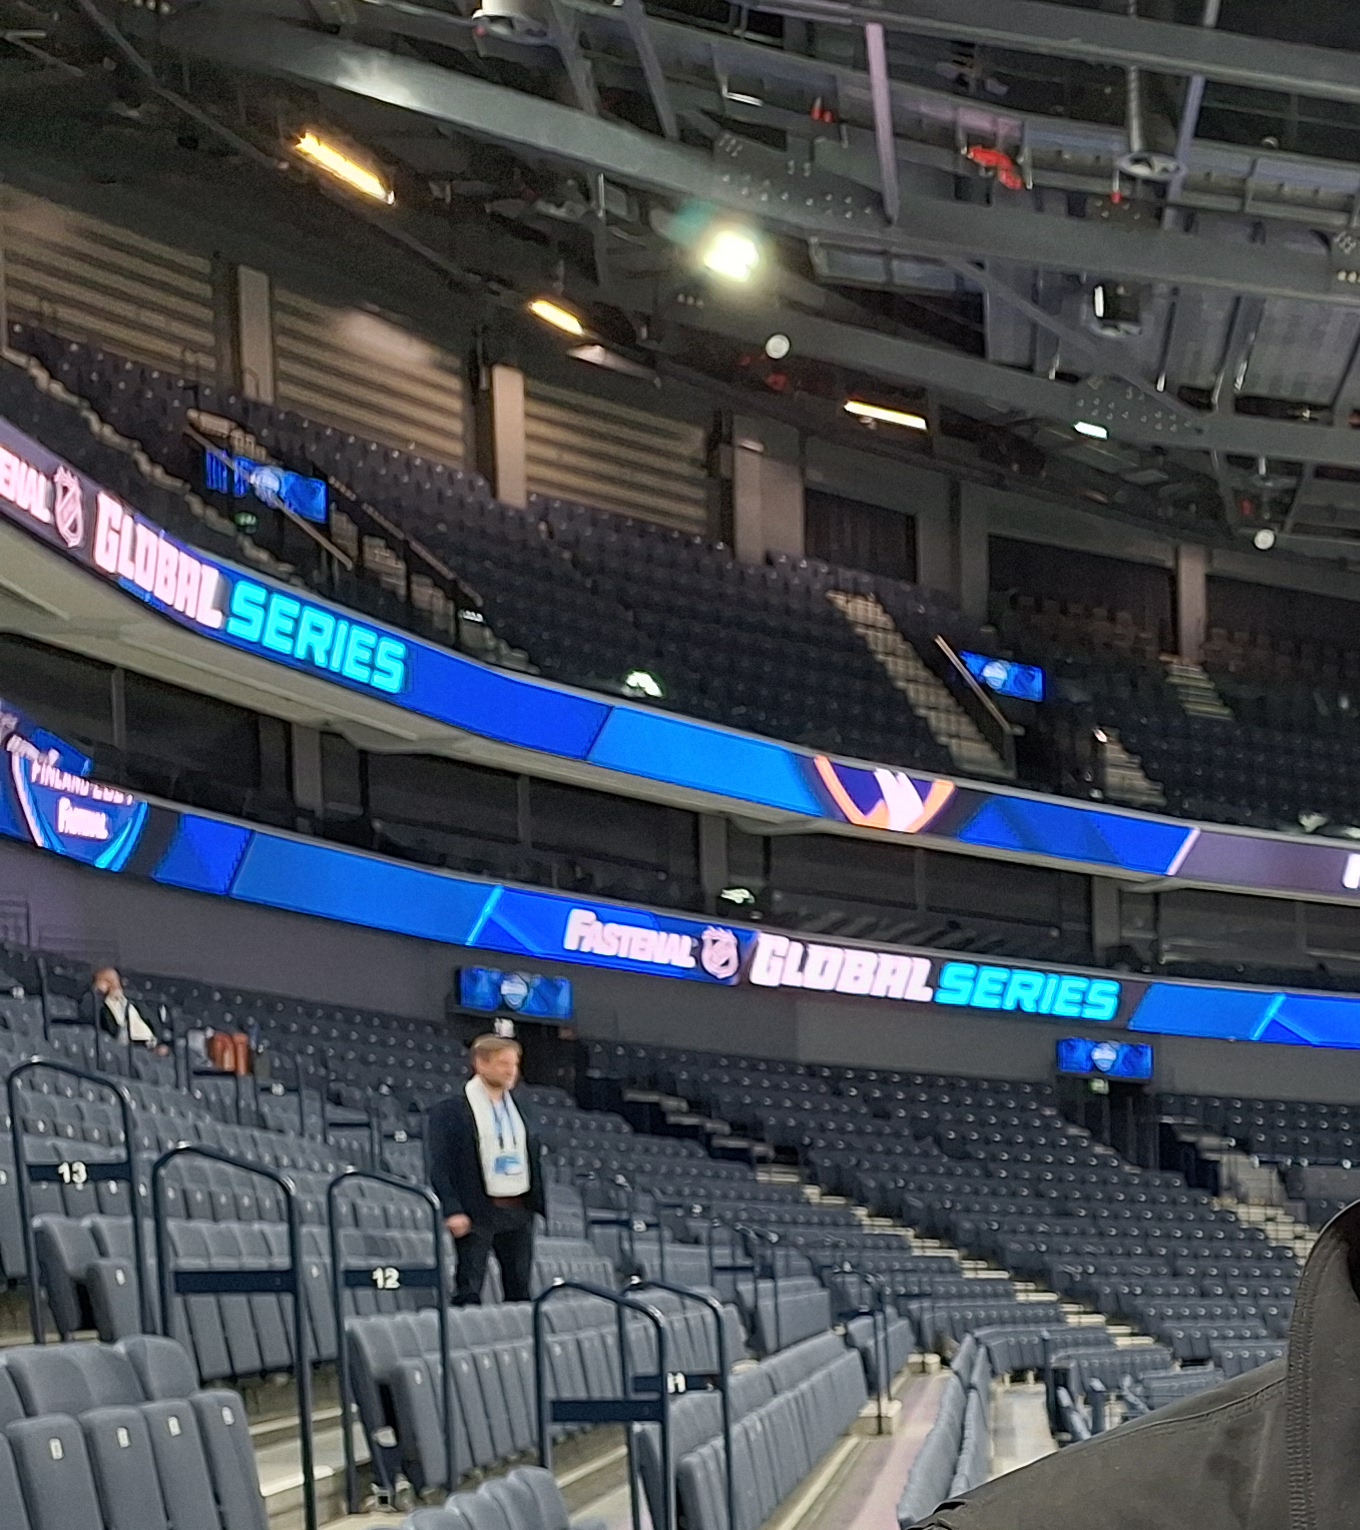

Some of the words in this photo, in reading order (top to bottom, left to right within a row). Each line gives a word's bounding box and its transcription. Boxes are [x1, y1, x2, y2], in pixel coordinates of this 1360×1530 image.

[93, 492, 225, 630] GLOBAL
[226, 580, 408, 694] SERIES
[564, 908, 696, 969] FASTENAL
[749, 932, 934, 1002] GLOBAL
[935, 961, 1122, 1020] SERIES
[57, 1161, 88, 1184] 13
[372, 1267, 401, 1290] 12
